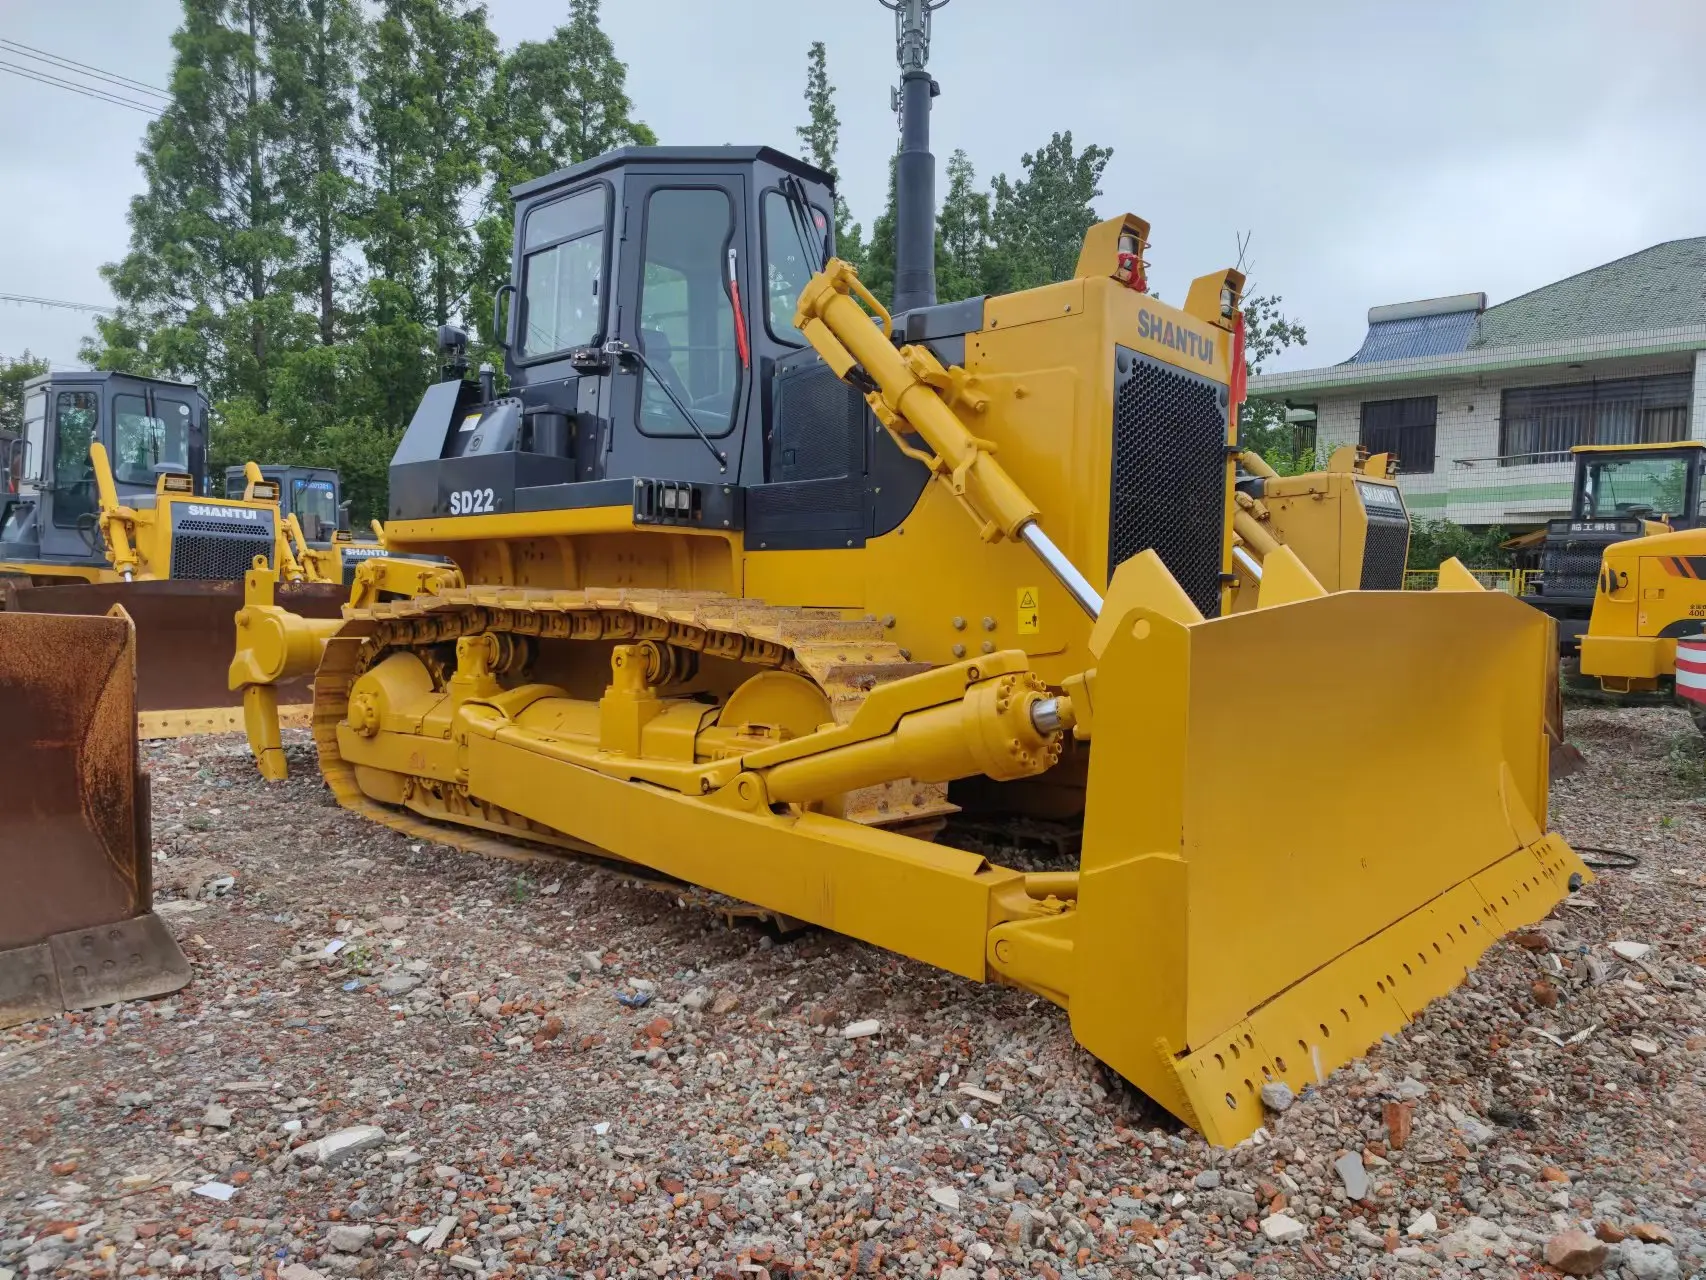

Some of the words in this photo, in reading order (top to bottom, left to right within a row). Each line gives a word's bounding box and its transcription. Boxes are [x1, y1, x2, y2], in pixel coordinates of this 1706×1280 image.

[1137, 308, 1213, 365] SHANTUI
[450, 488, 494, 515] SD22
[1361, 485, 1397, 504] SHANTUI
[188, 505, 257, 520] SHANTUI
[345, 549, 389, 557] SHANTU
